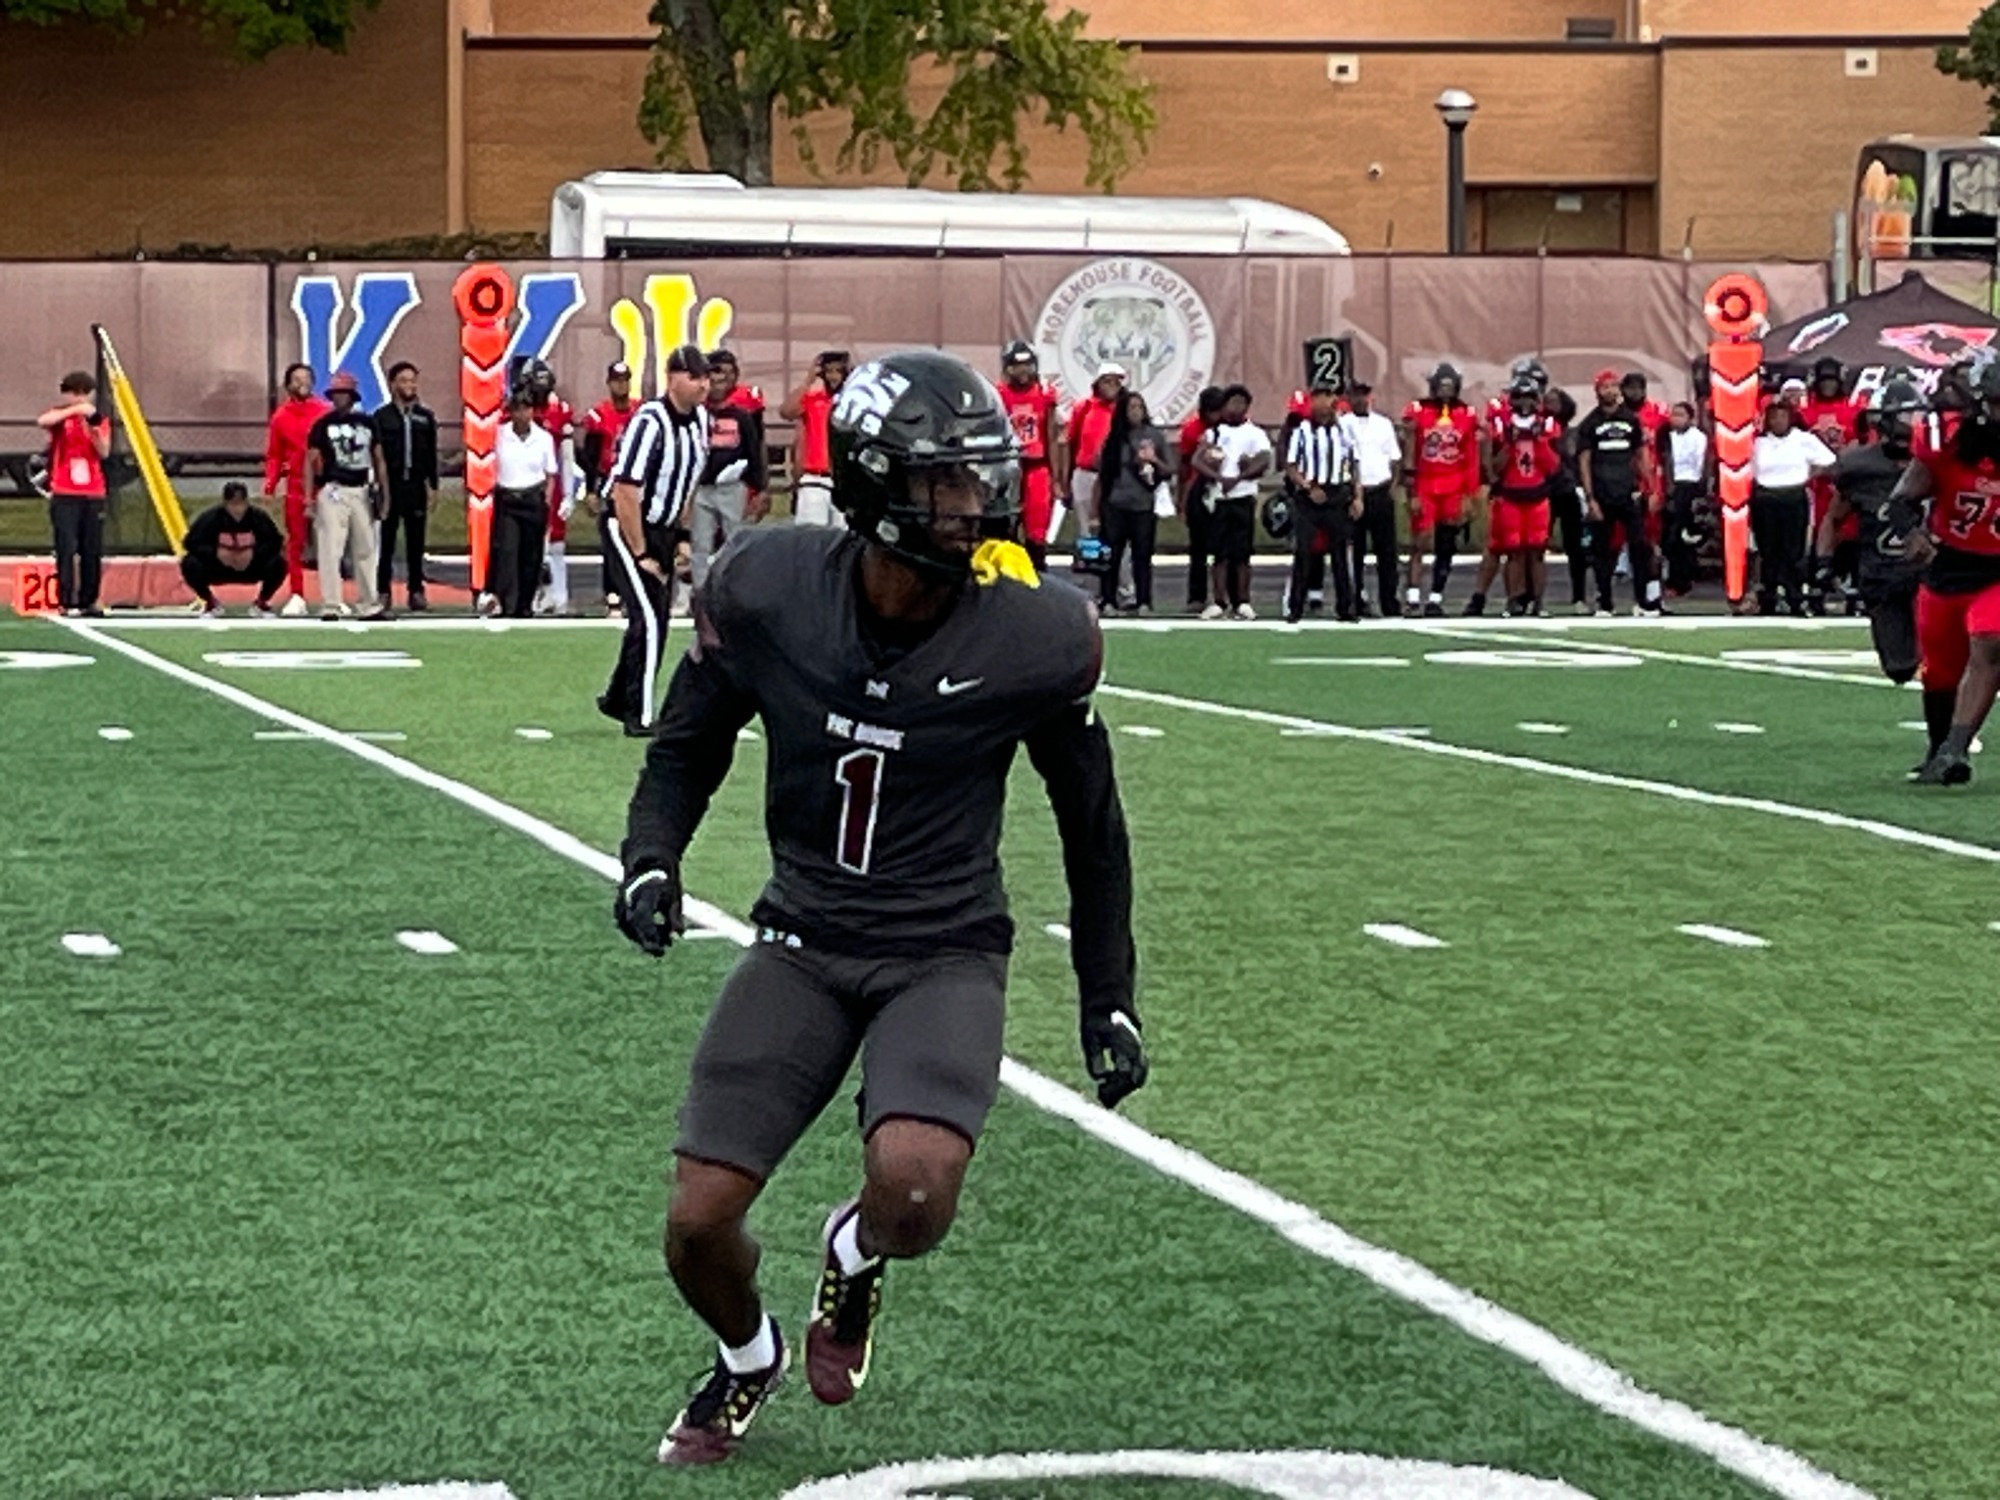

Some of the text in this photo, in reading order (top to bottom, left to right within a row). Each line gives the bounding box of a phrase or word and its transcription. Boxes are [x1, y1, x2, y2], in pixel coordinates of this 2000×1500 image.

[1042, 262, 1208, 347] MOREHOUSE FOOTBALL
[1313, 342, 1342, 392] 2
[23, 572, 61, 612] 20
[835, 748, 885, 875] 1
